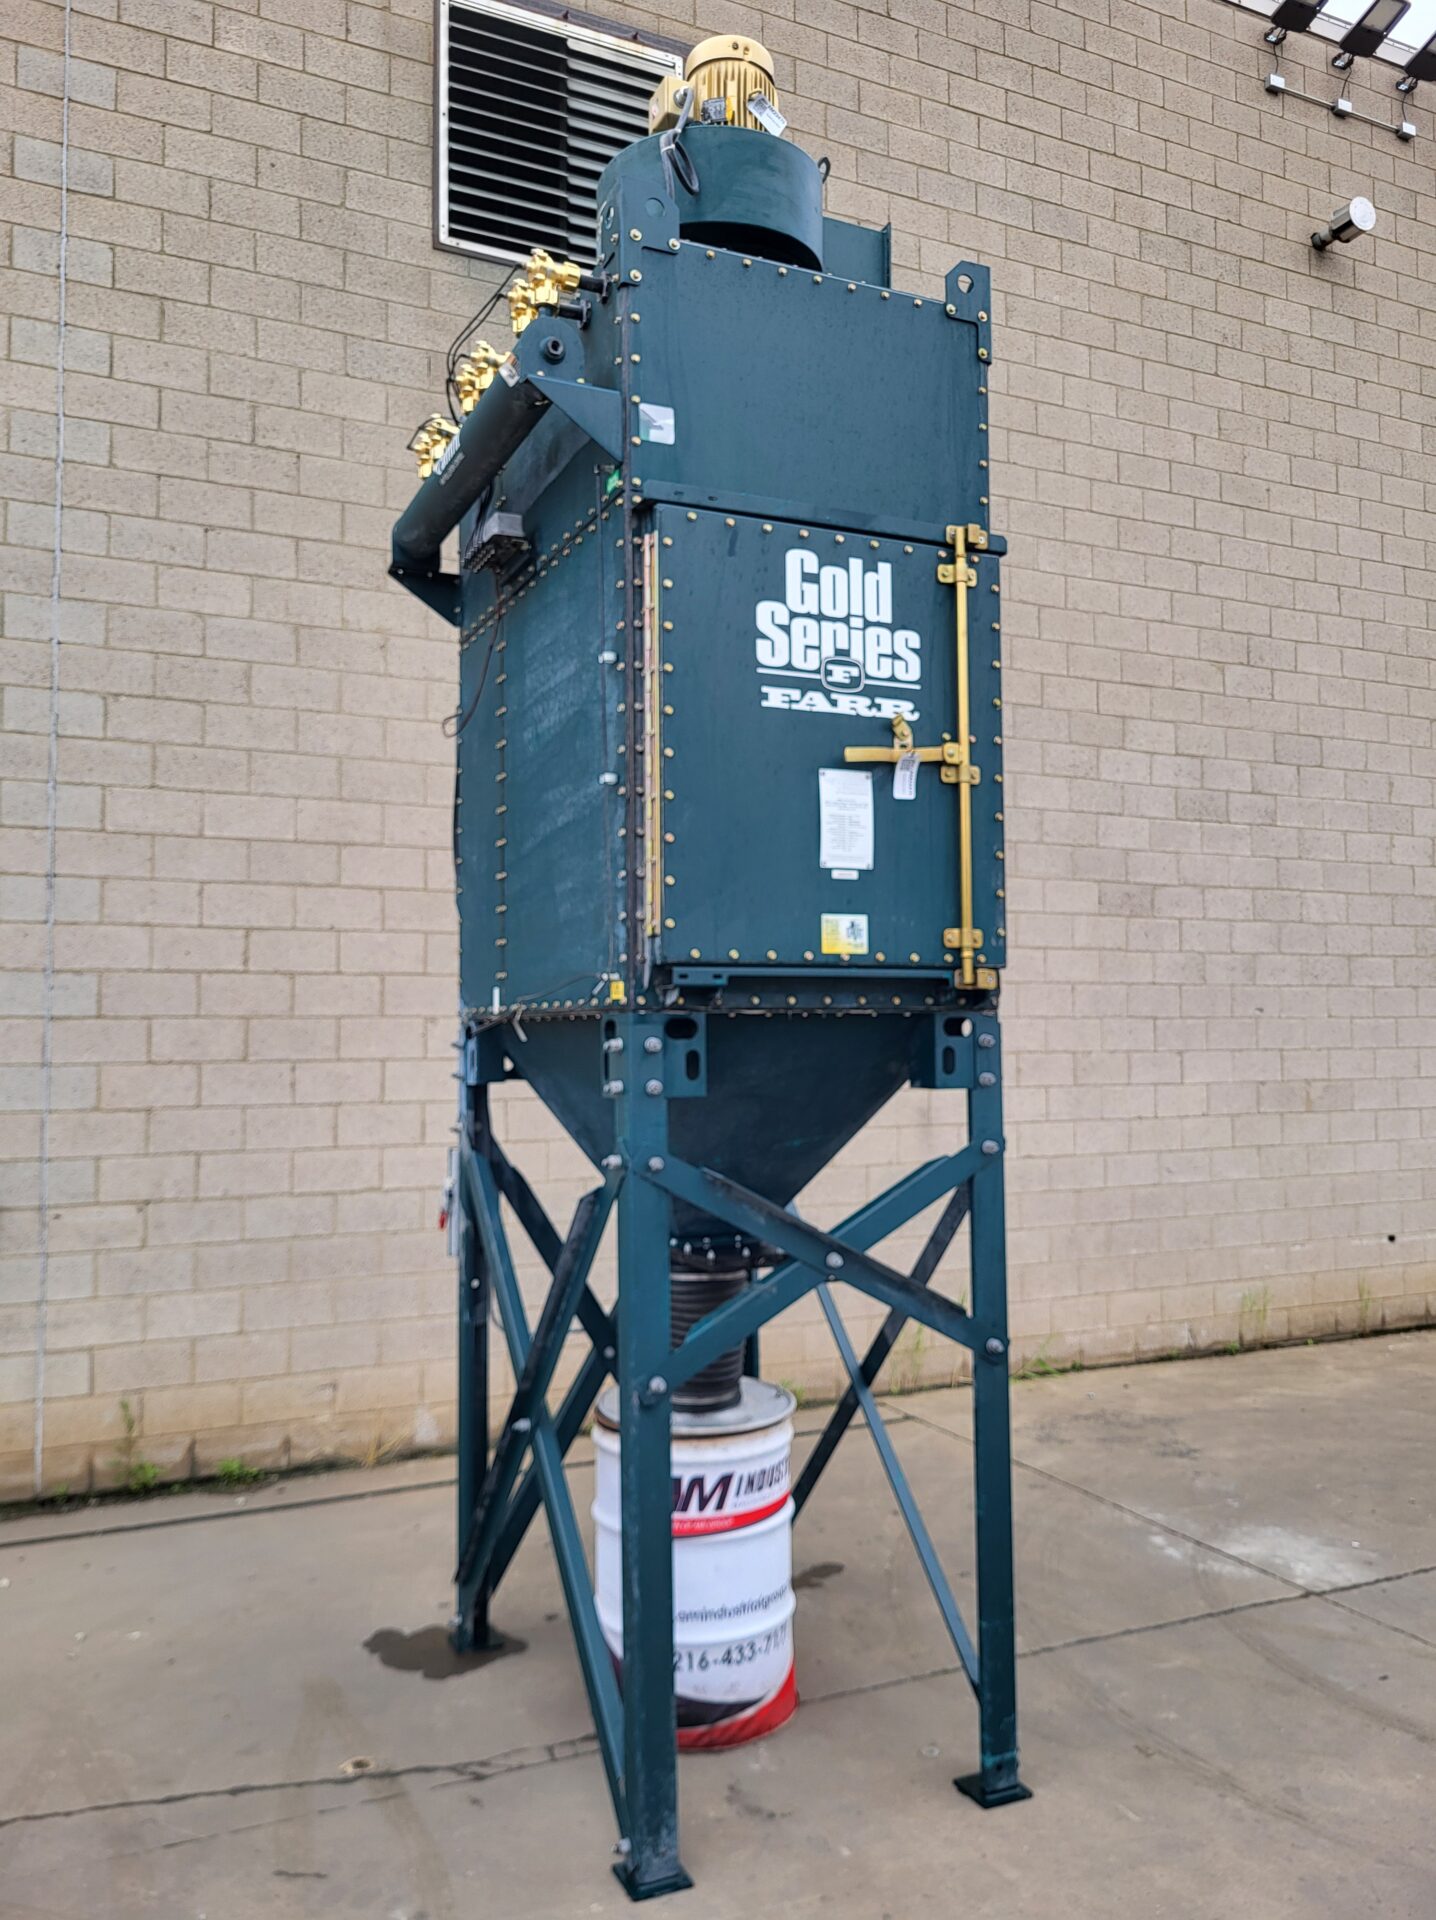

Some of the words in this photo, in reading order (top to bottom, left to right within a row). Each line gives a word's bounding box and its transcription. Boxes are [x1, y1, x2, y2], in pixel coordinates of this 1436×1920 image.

[785, 549, 892, 624] Gold
[755, 600, 921, 682] Series
[761, 685, 920, 721] FARR
